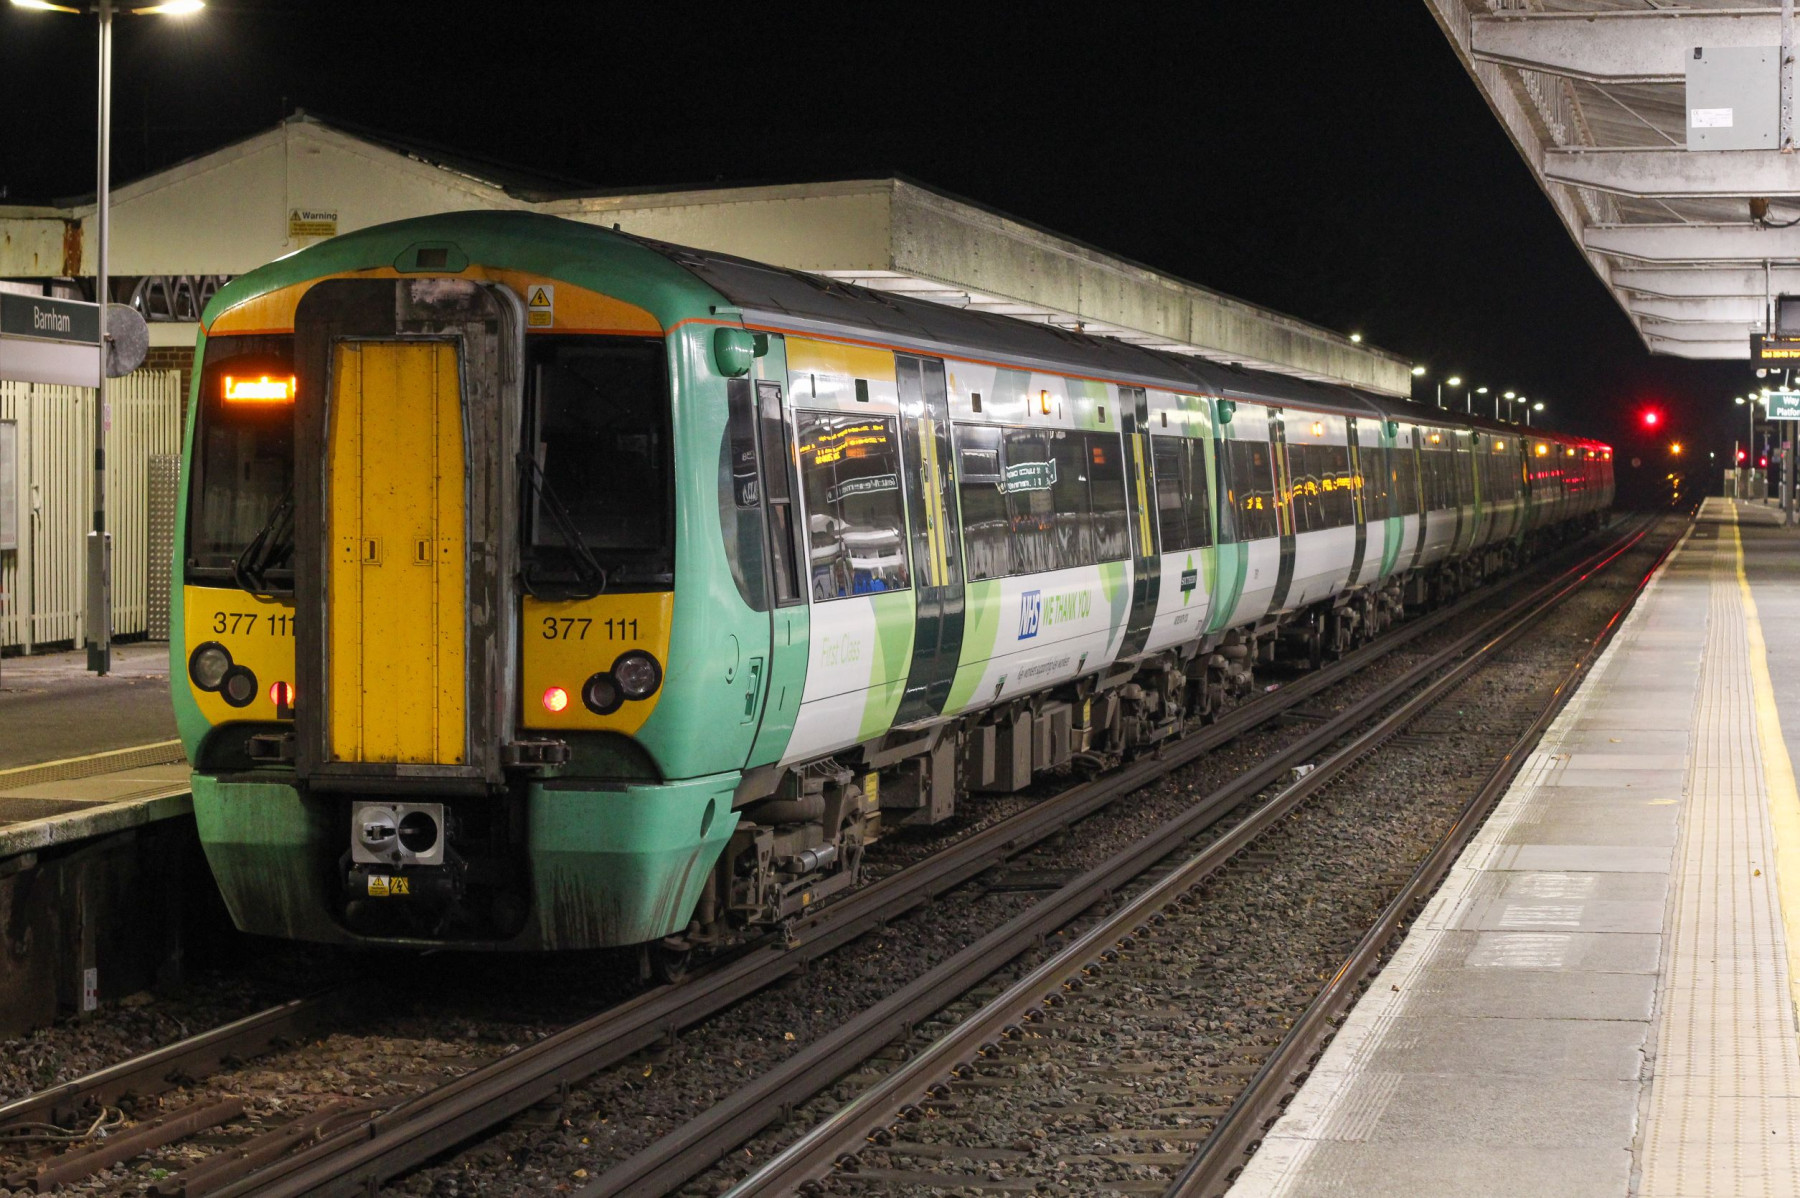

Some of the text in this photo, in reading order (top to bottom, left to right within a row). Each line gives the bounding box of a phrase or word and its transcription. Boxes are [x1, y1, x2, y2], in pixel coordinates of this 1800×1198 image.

[302, 211, 338, 221] Warning
[33, 305, 71, 332] Barnham
[1783, 395, 1800, 407] Way
[1019, 593, 1040, 638] NHS
[1042, 589, 1092, 627] WE THANK YOU
[213, 611, 296, 637] 377 111
[542, 617, 638, 641] 377 111
[821, 631, 861, 668] First Class
